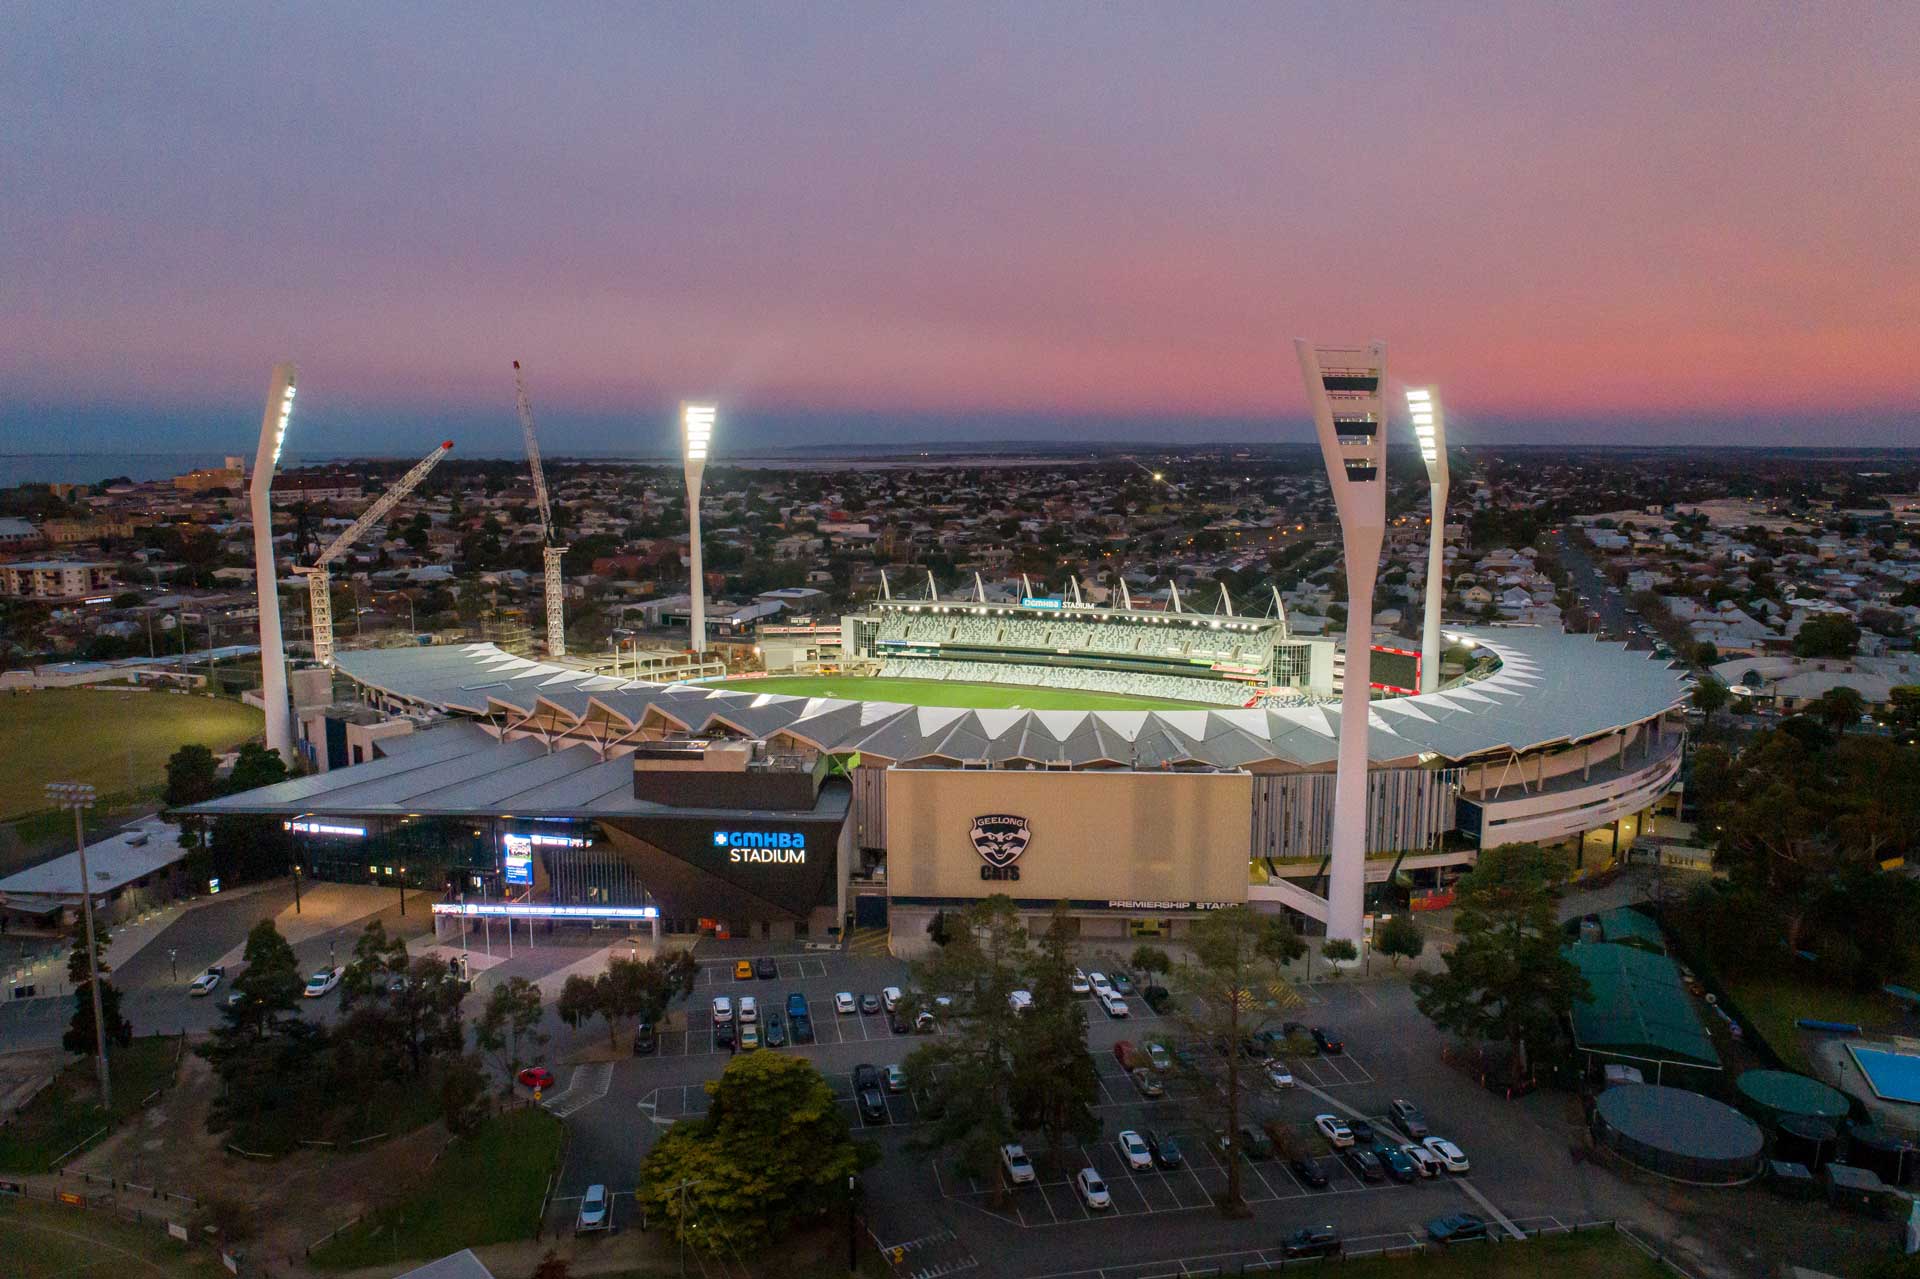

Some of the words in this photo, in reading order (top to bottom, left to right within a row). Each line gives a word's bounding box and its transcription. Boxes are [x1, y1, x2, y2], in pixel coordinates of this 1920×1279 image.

[1062, 601, 1095, 610] STADIUM
[977, 816, 1024, 827] GEELONG
[730, 848, 805, 863] STADIUM
[981, 865, 1020, 881] CATS
[1108, 900, 1190, 909] PREMIERSHIP
